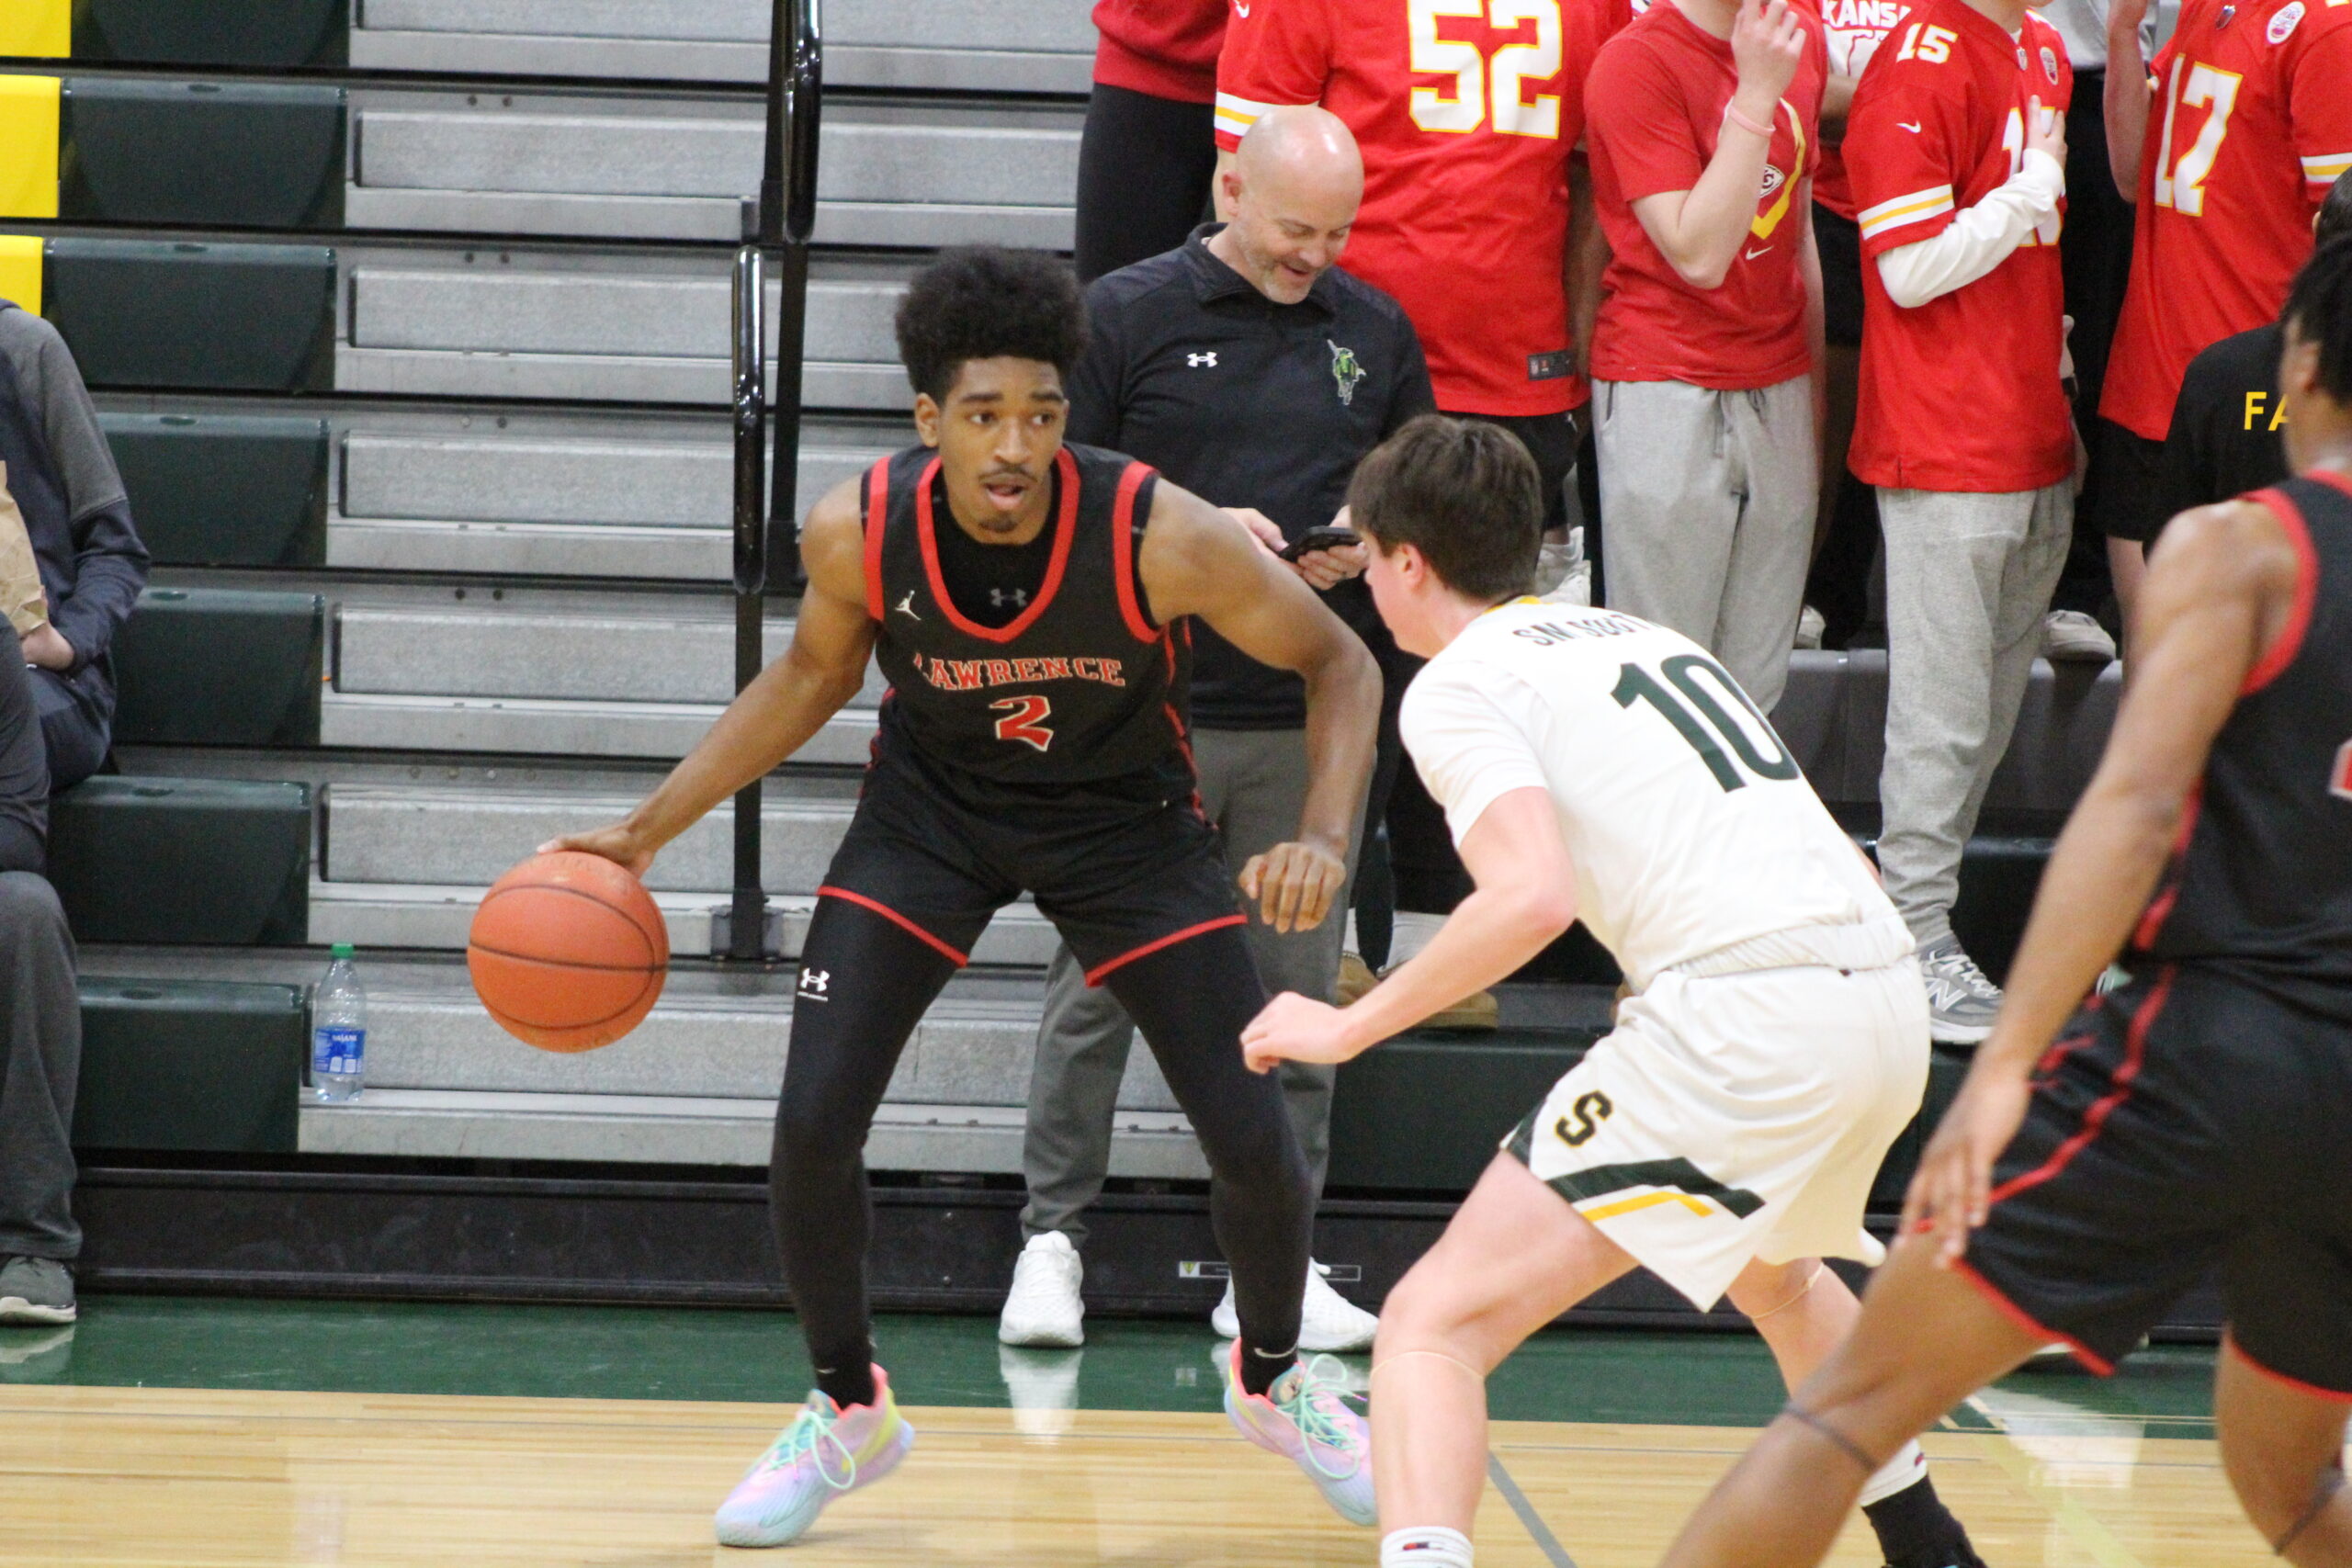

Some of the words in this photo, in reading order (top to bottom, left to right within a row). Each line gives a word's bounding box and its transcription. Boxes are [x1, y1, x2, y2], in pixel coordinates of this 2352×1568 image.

[1408, 0, 1563, 139] 52
[1896, 22, 1959, 64] 15
[2154, 52, 2244, 217] 17
[989, 695, 1055, 752] 2
[1610, 654, 1800, 794] 10
[1555, 1089, 1613, 1147] S
